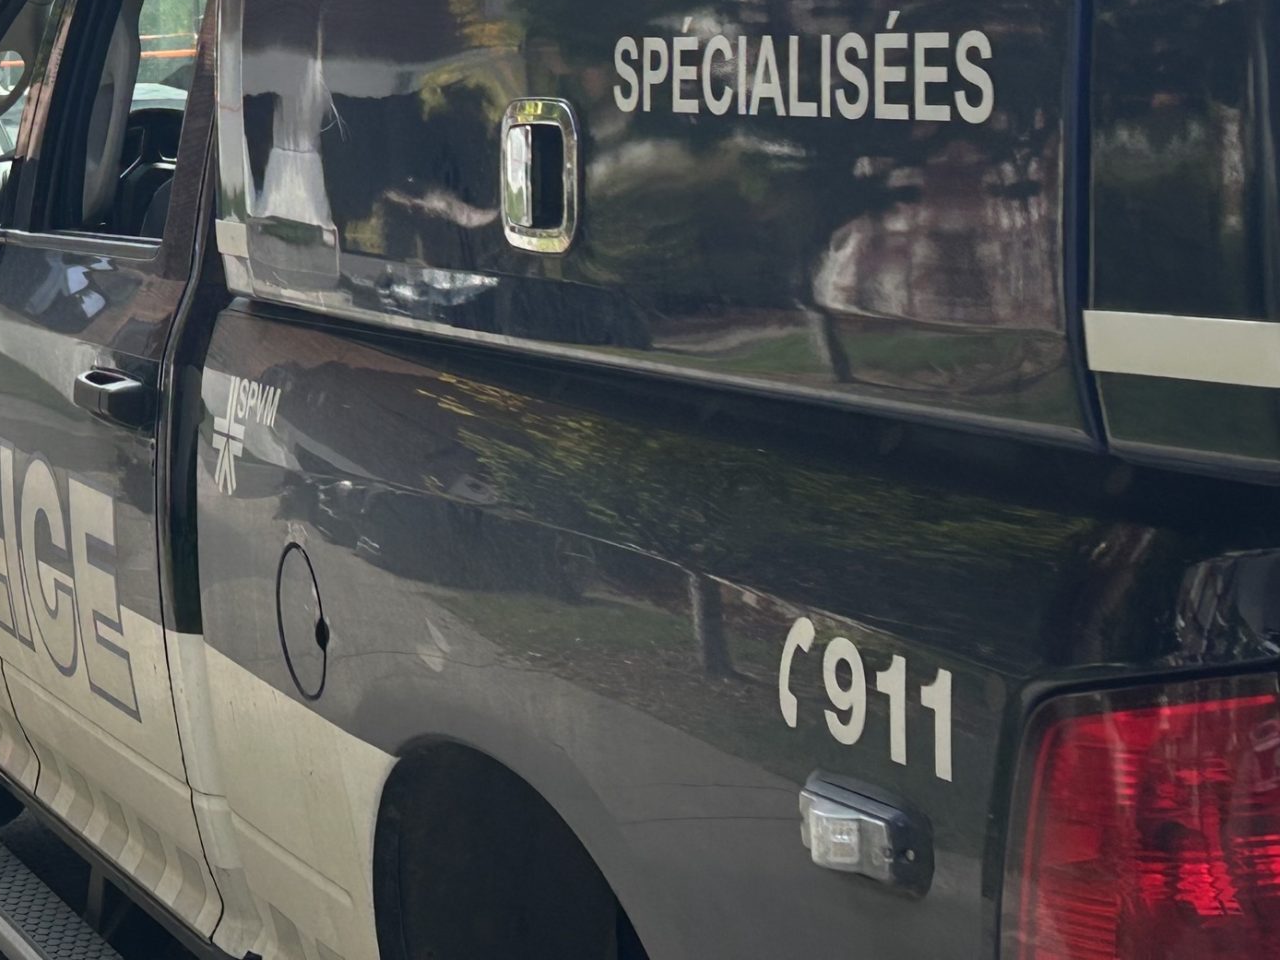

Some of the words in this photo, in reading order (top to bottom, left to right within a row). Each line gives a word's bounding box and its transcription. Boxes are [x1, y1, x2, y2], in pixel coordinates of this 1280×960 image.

[613, 11, 996, 125] SPÉCIALISÉES
[237, 378, 282, 428] SPVM
[822, 636, 954, 783] 911
